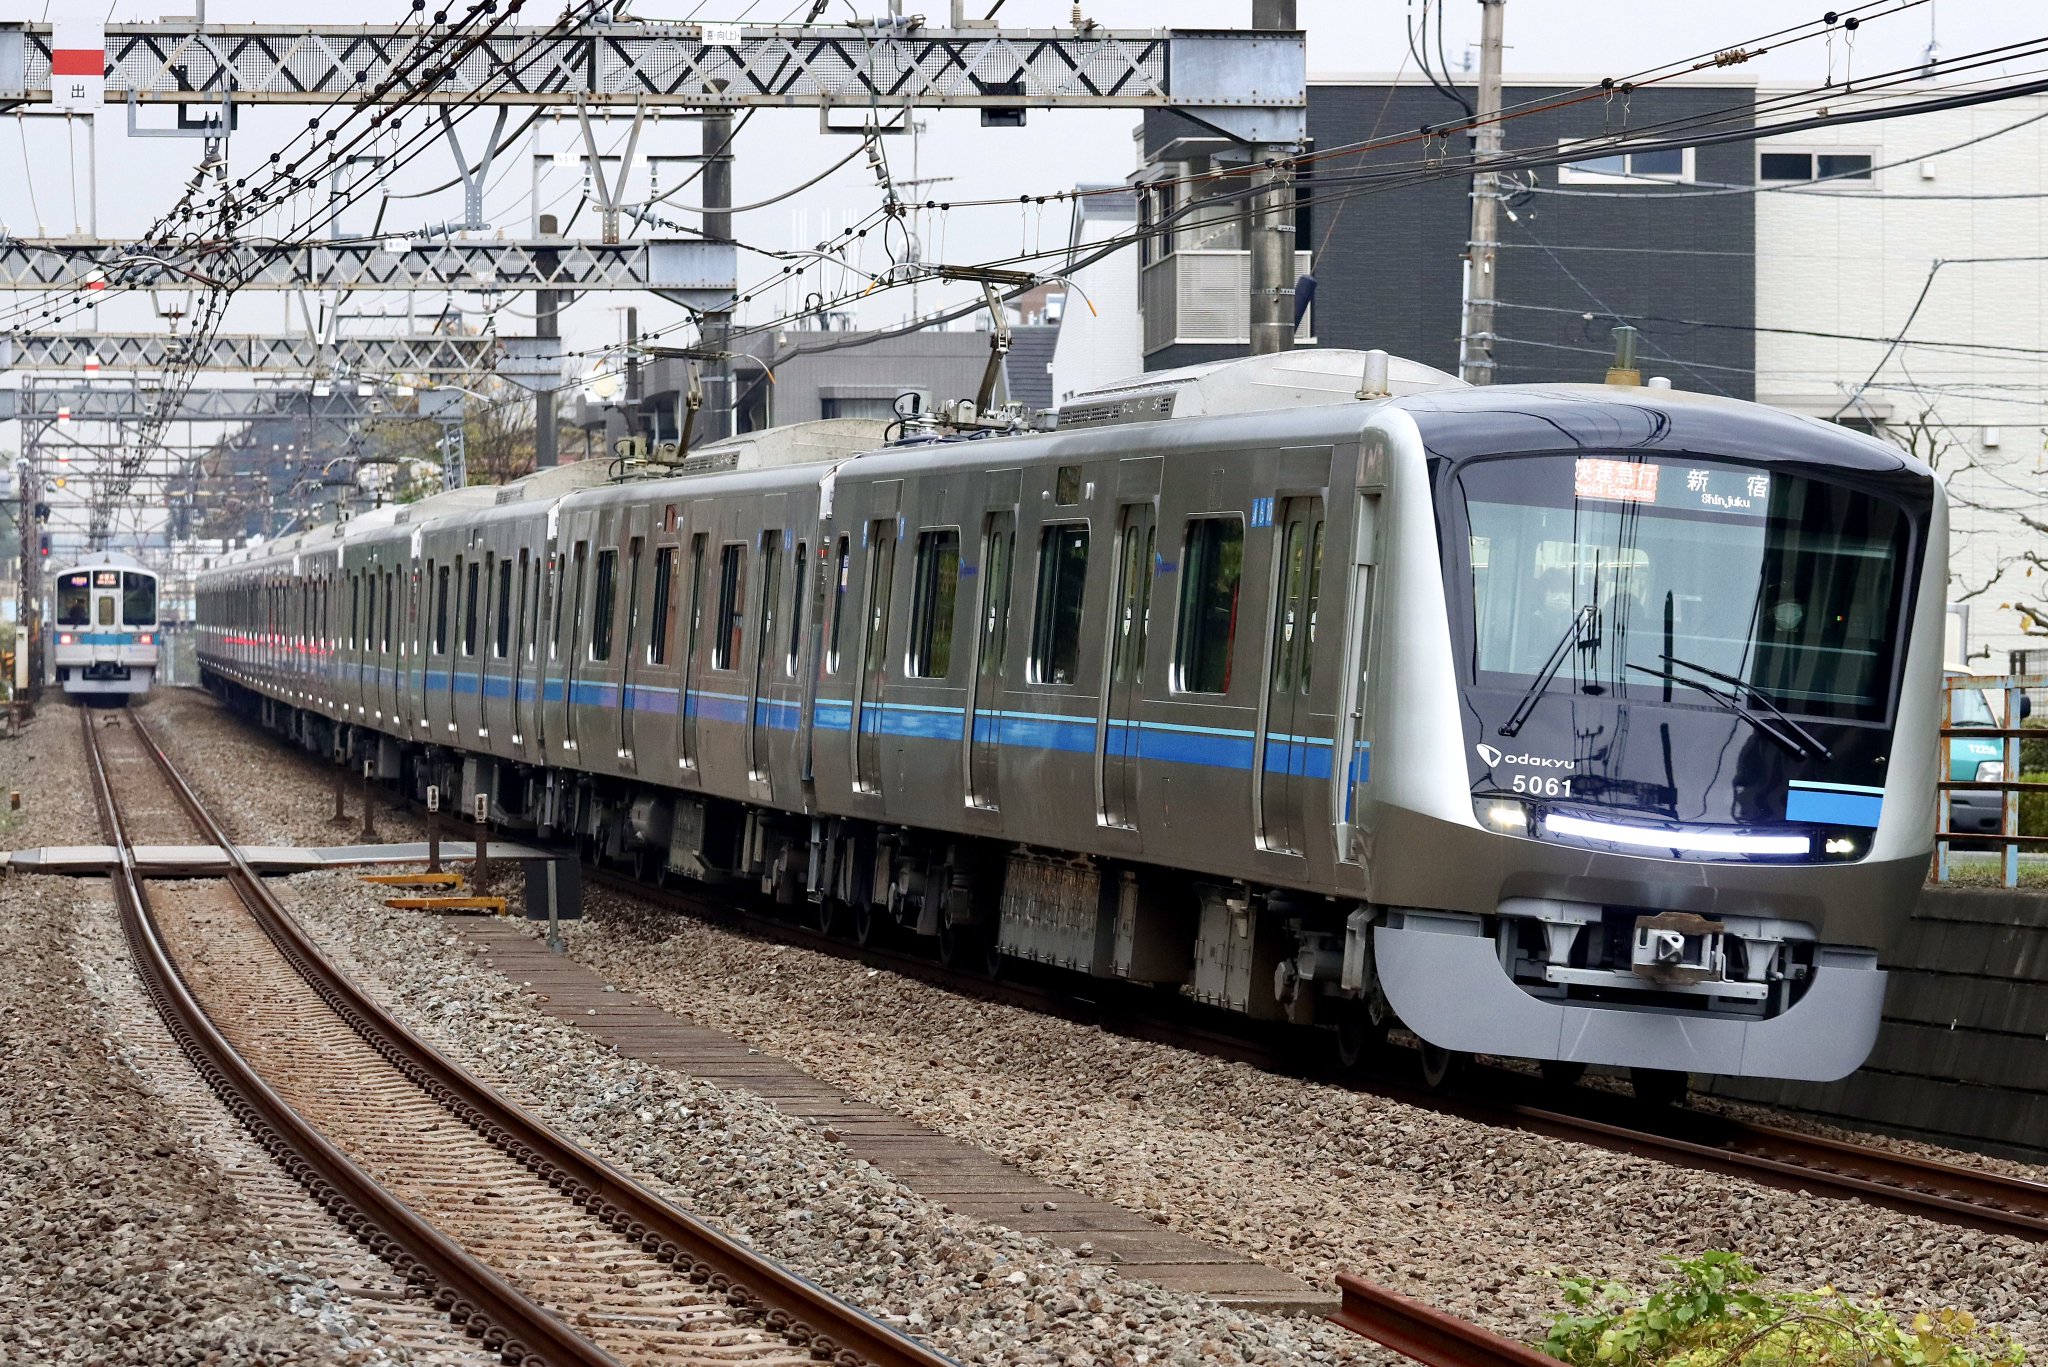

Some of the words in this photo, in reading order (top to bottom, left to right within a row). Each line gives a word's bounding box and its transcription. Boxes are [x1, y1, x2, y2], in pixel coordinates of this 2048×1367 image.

[1575, 459, 1658, 486] 快速急行
[1687, 468, 1769, 498] 新宿
[1512, 774, 1572, 798] 5061
